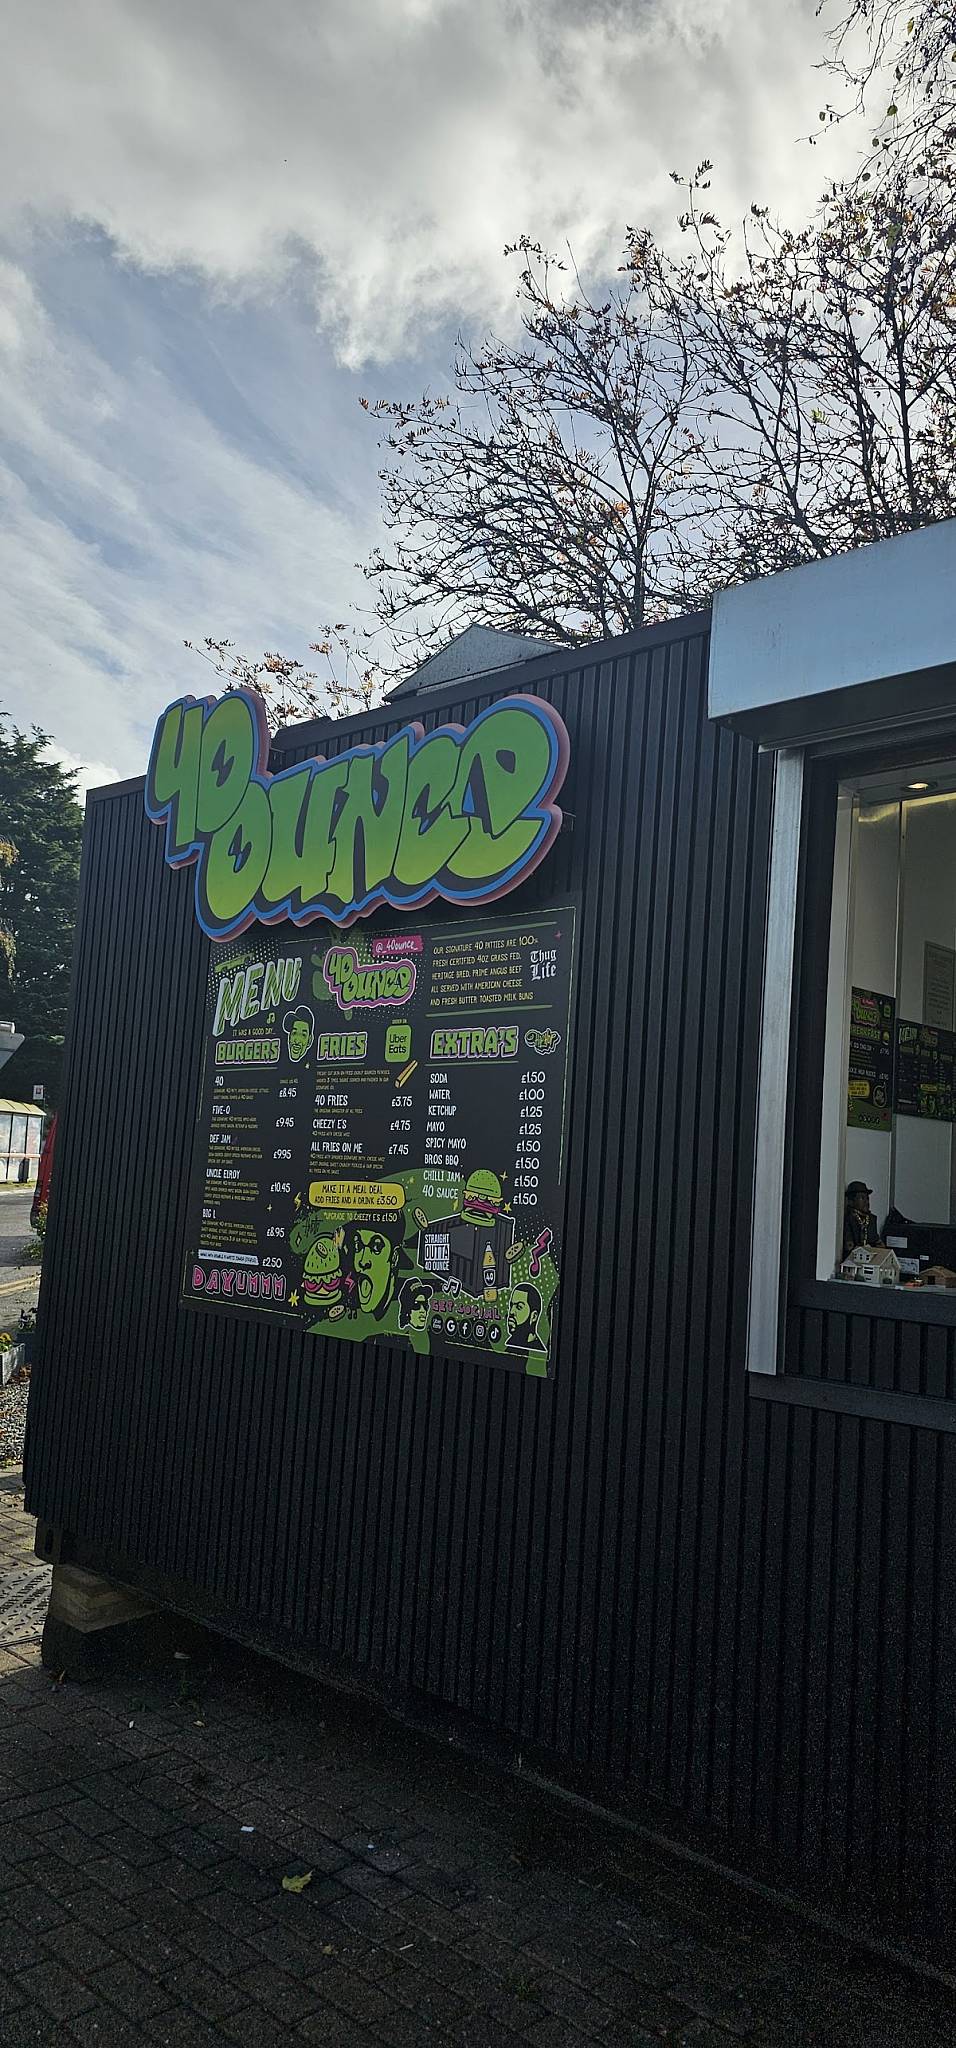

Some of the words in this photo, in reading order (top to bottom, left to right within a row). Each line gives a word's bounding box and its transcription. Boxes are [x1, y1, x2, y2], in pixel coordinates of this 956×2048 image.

[150, 693, 258, 852] 40
[203, 705, 555, 922] OUNCE
[433, 946, 444, 955] OUR
[445, 944, 472, 954] SIGNATURE
[474, 940, 484, 950] 40
[484, 940, 504, 949] PATTIES
[506, 938, 517, 947] ARE
[432, 960, 448, 968] FRESH
[450, 956, 475, 966] CERTIFIED
[490, 954, 508, 962] GRASS
[530, 949, 557, 963] Thug
[328, 951, 355, 986] 40
[431, 970, 454, 980] HERITAGE
[472, 968, 488, 977] PRIME
[490, 967, 508, 976] ANGUS
[509, 966, 522, 974] BEEF
[530, 962, 557, 981] Life
[440, 984, 460, 993] SERVED
[460, 983, 474, 992] WITH
[474, 981, 501, 991] AMERICAN
[502, 979, 523, 988] CHEESE
[212, 957, 302, 1036] MENU
[430, 998, 440, 1006] AND
[442, 998, 458, 1006] FRESH
[458, 996, 478, 1004] BUTTER
[480, 994, 502, 1004] TOASTED
[504, 993, 517, 1002] MILK
[390, 1034, 407, 1043] Uber
[432, 1028, 518, 1056] EXTRA'S
[215, 1040, 279, 1063] BURGERS
[319, 1034, 366, 1058] FRIES
[389, 1044, 406, 1054] Eats
[214, 1076, 224, 1086] 40
[430, 1073, 448, 1084] SODA
[314, 1094, 326, 1106] 40
[327, 1094, 348, 1106] FRIES
[392, 1096, 412, 1107] £3.75
[430, 1089, 451, 1100] WATER
[428, 1105, 457, 1116] KETCHUP
[312, 1119, 336, 1129] CHEEZY
[390, 1120, 411, 1131] £4.75
[426, 1122, 446, 1132] MAYO
[310, 1142, 320, 1152] ALL
[322, 1142, 340, 1152] FRIES
[342, 1142, 352, 1152] ON
[353, 1143, 363, 1153] ME
[388, 1144, 409, 1155] £7.45
[426, 1137, 446, 1148] SPICY
[448, 1138, 466, 1150] MAYO
[424, 1154, 442, 1166] BROS
[445, 1155, 459, 1166] BBQ
[423, 1170, 446, 1182] CHILLI
[448, 1172, 460, 1182] JAM
[322, 1184, 337, 1194] MAKE
[338, 1184, 344, 1194] IT
[346, 1184, 350, 1194] A
[352, 1184, 367, 1194] MEAL
[369, 1184, 383, 1194] DEAL
[422, 1184, 434, 1198] 40
[436, 1188, 458, 1200] SAUCE
[326, 1196, 340, 1204] FRIES
[342, 1196, 351, 1204] AND
[357, 1197, 375, 1205] DRINK
[376, 1196, 398, 1206] £3.50
[202, 1208, 212, 1218] BIG
[424, 1233, 450, 1244] STRAIGHT
[425, 1244, 449, 1260] OUTTA
[192, 1265, 286, 1300] DAYUMMM
[432, 1300, 454, 1312] GET
